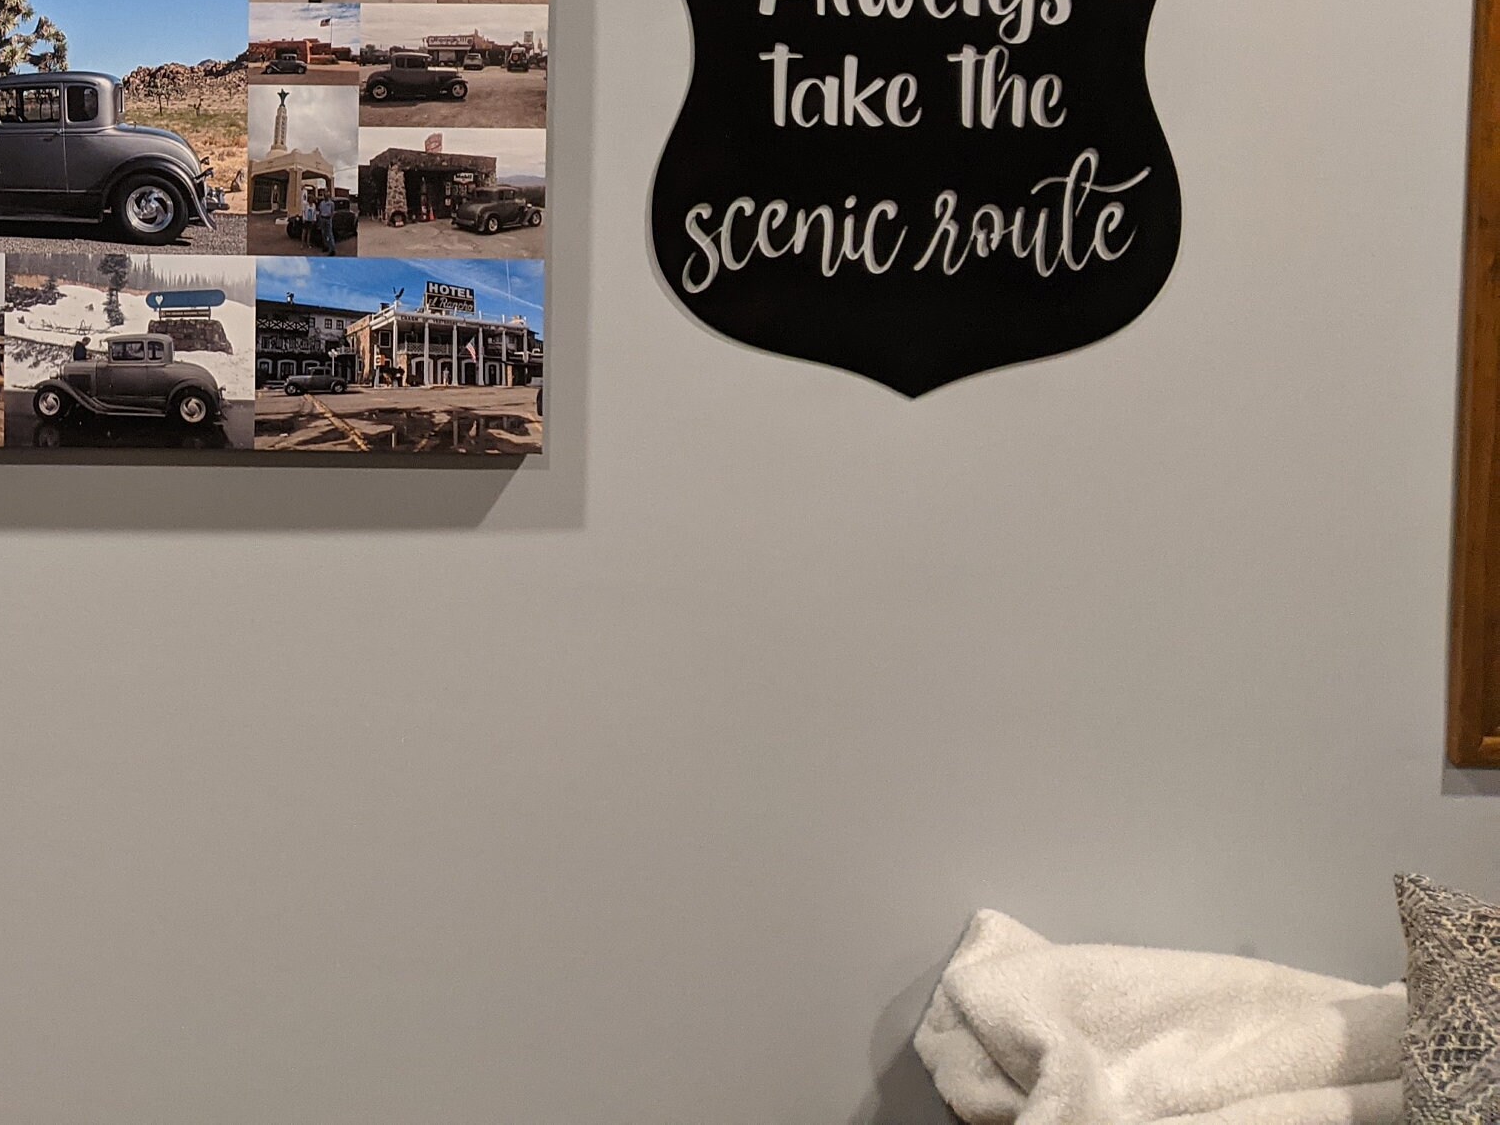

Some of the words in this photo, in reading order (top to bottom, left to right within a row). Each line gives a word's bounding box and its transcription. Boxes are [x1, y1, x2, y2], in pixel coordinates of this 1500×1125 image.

[758, 41, 923, 127] take
[946, 43, 1067, 130] the
[681, 194, 909, 294] scenic
[913, 147, 1152, 278] route
[428, 282, 473, 298] HOTEL
[440, 298, 474, 311] Rancho
